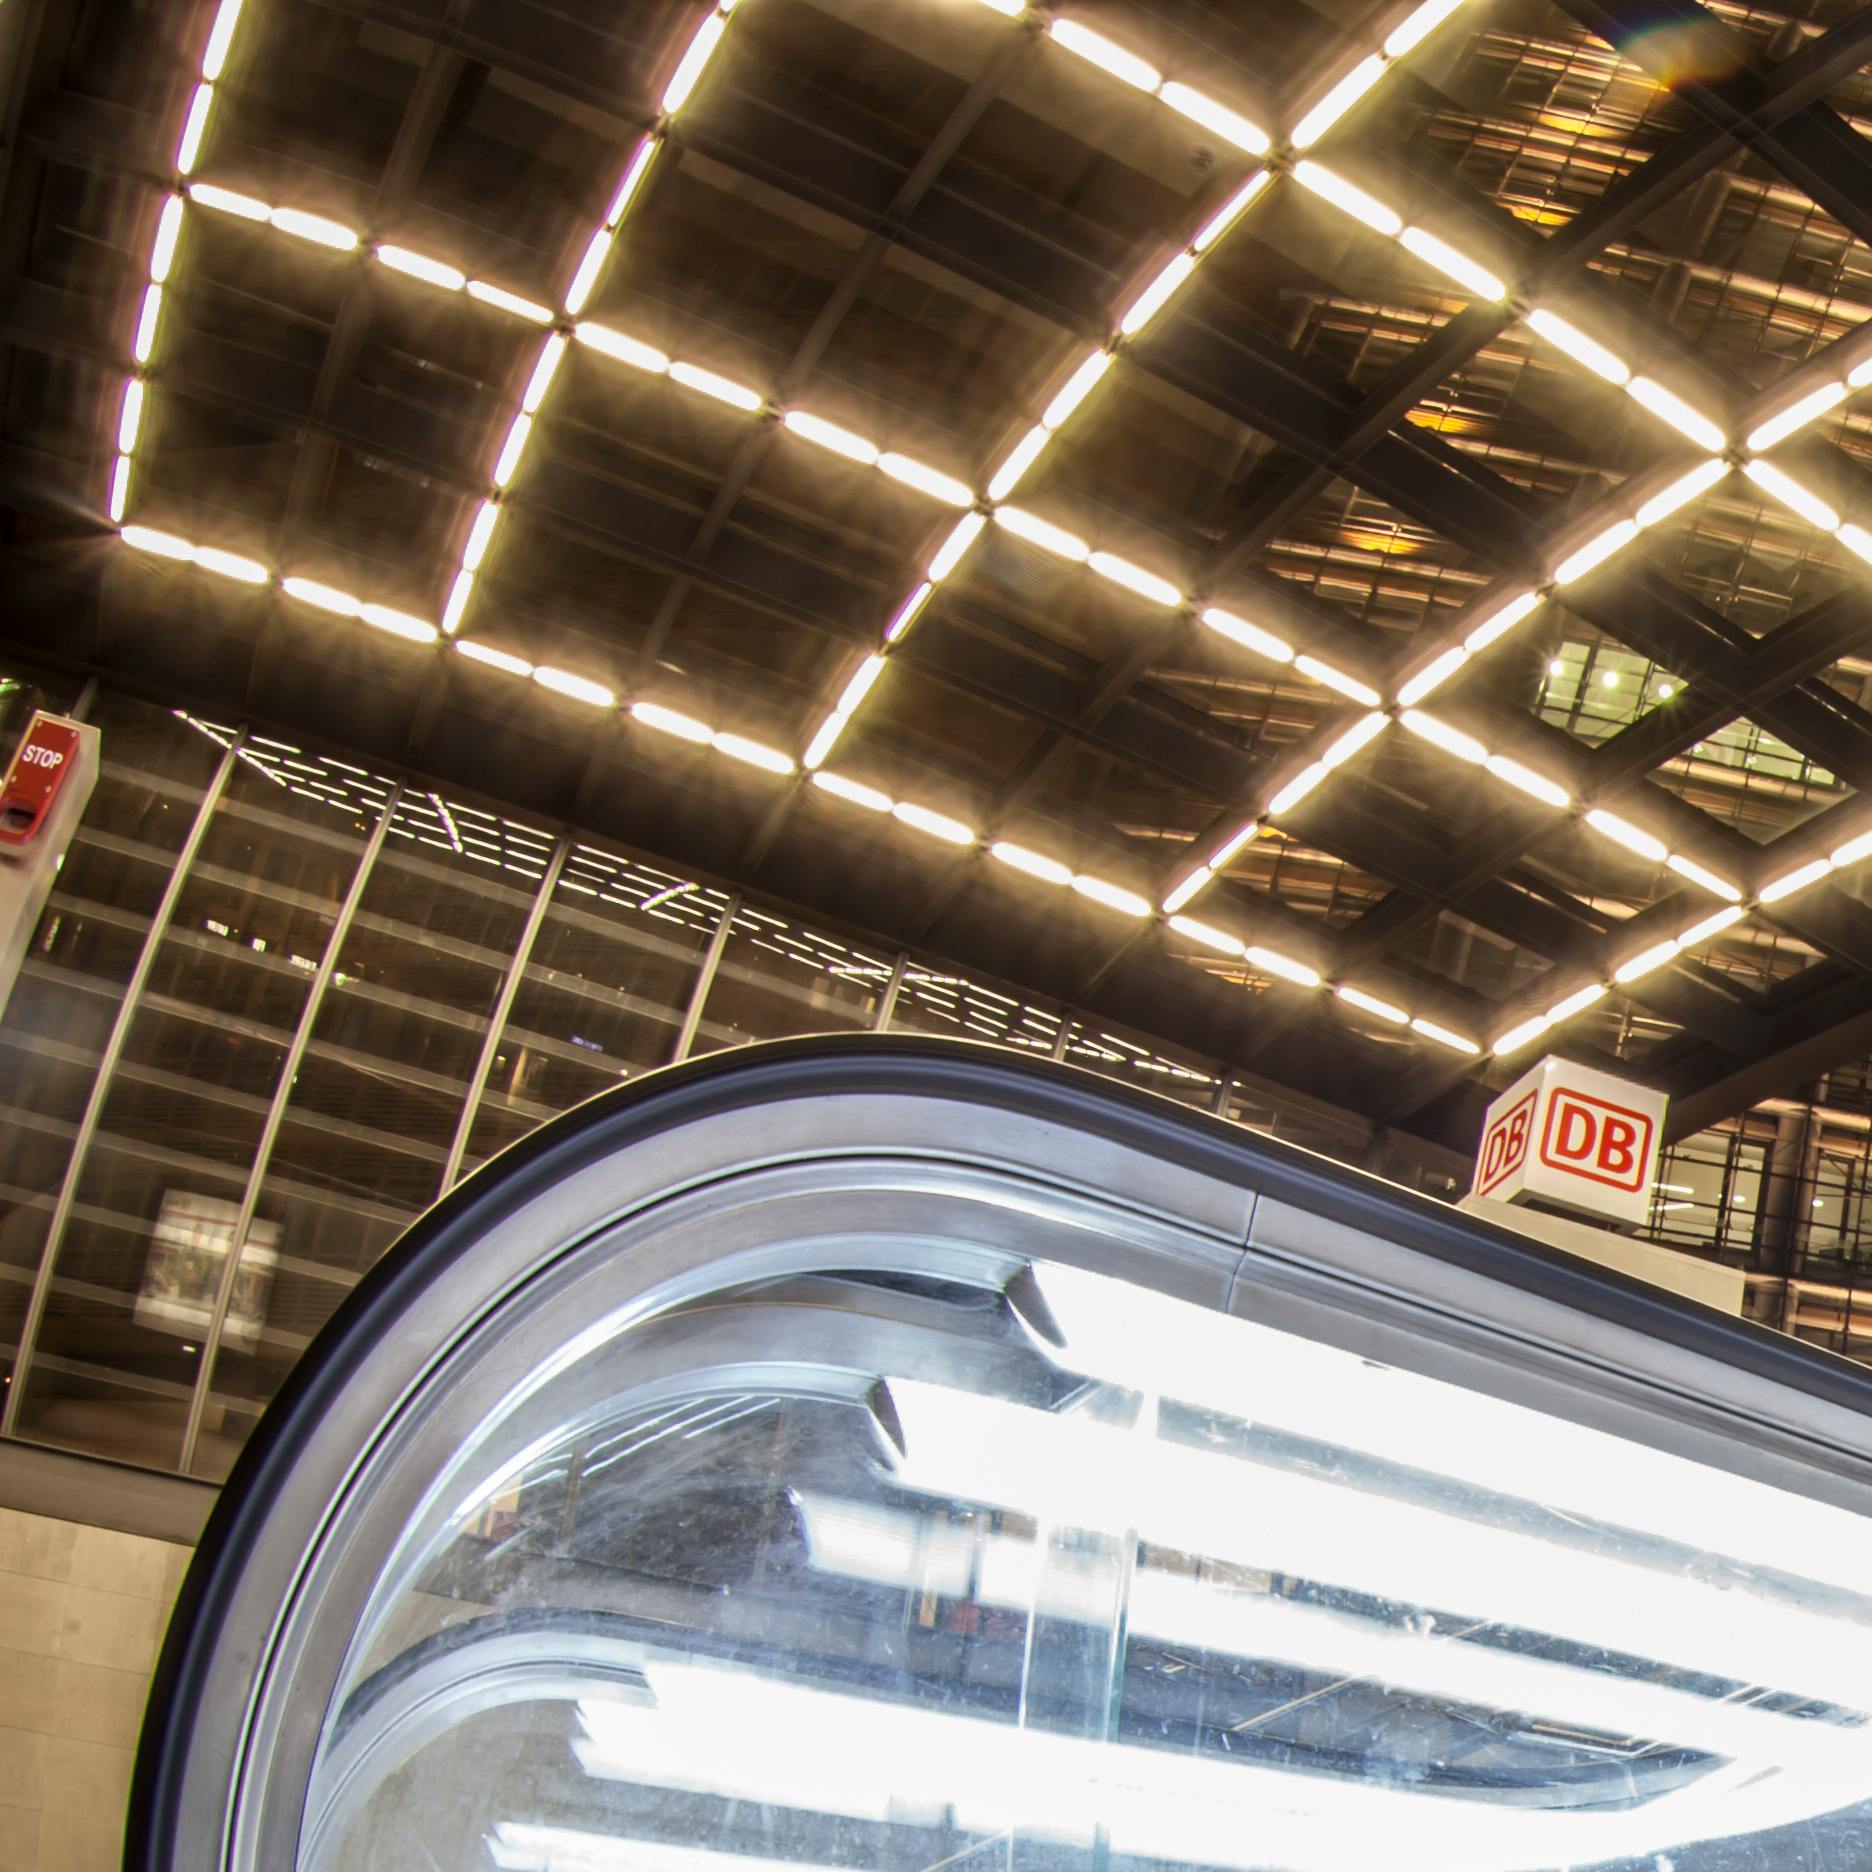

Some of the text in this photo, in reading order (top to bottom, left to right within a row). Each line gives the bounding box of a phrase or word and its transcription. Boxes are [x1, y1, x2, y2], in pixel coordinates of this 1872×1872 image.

[22, 744, 64, 769] STOP
[1483, 1108, 1528, 1185] DB
[1554, 1102, 1637, 1175] DB
